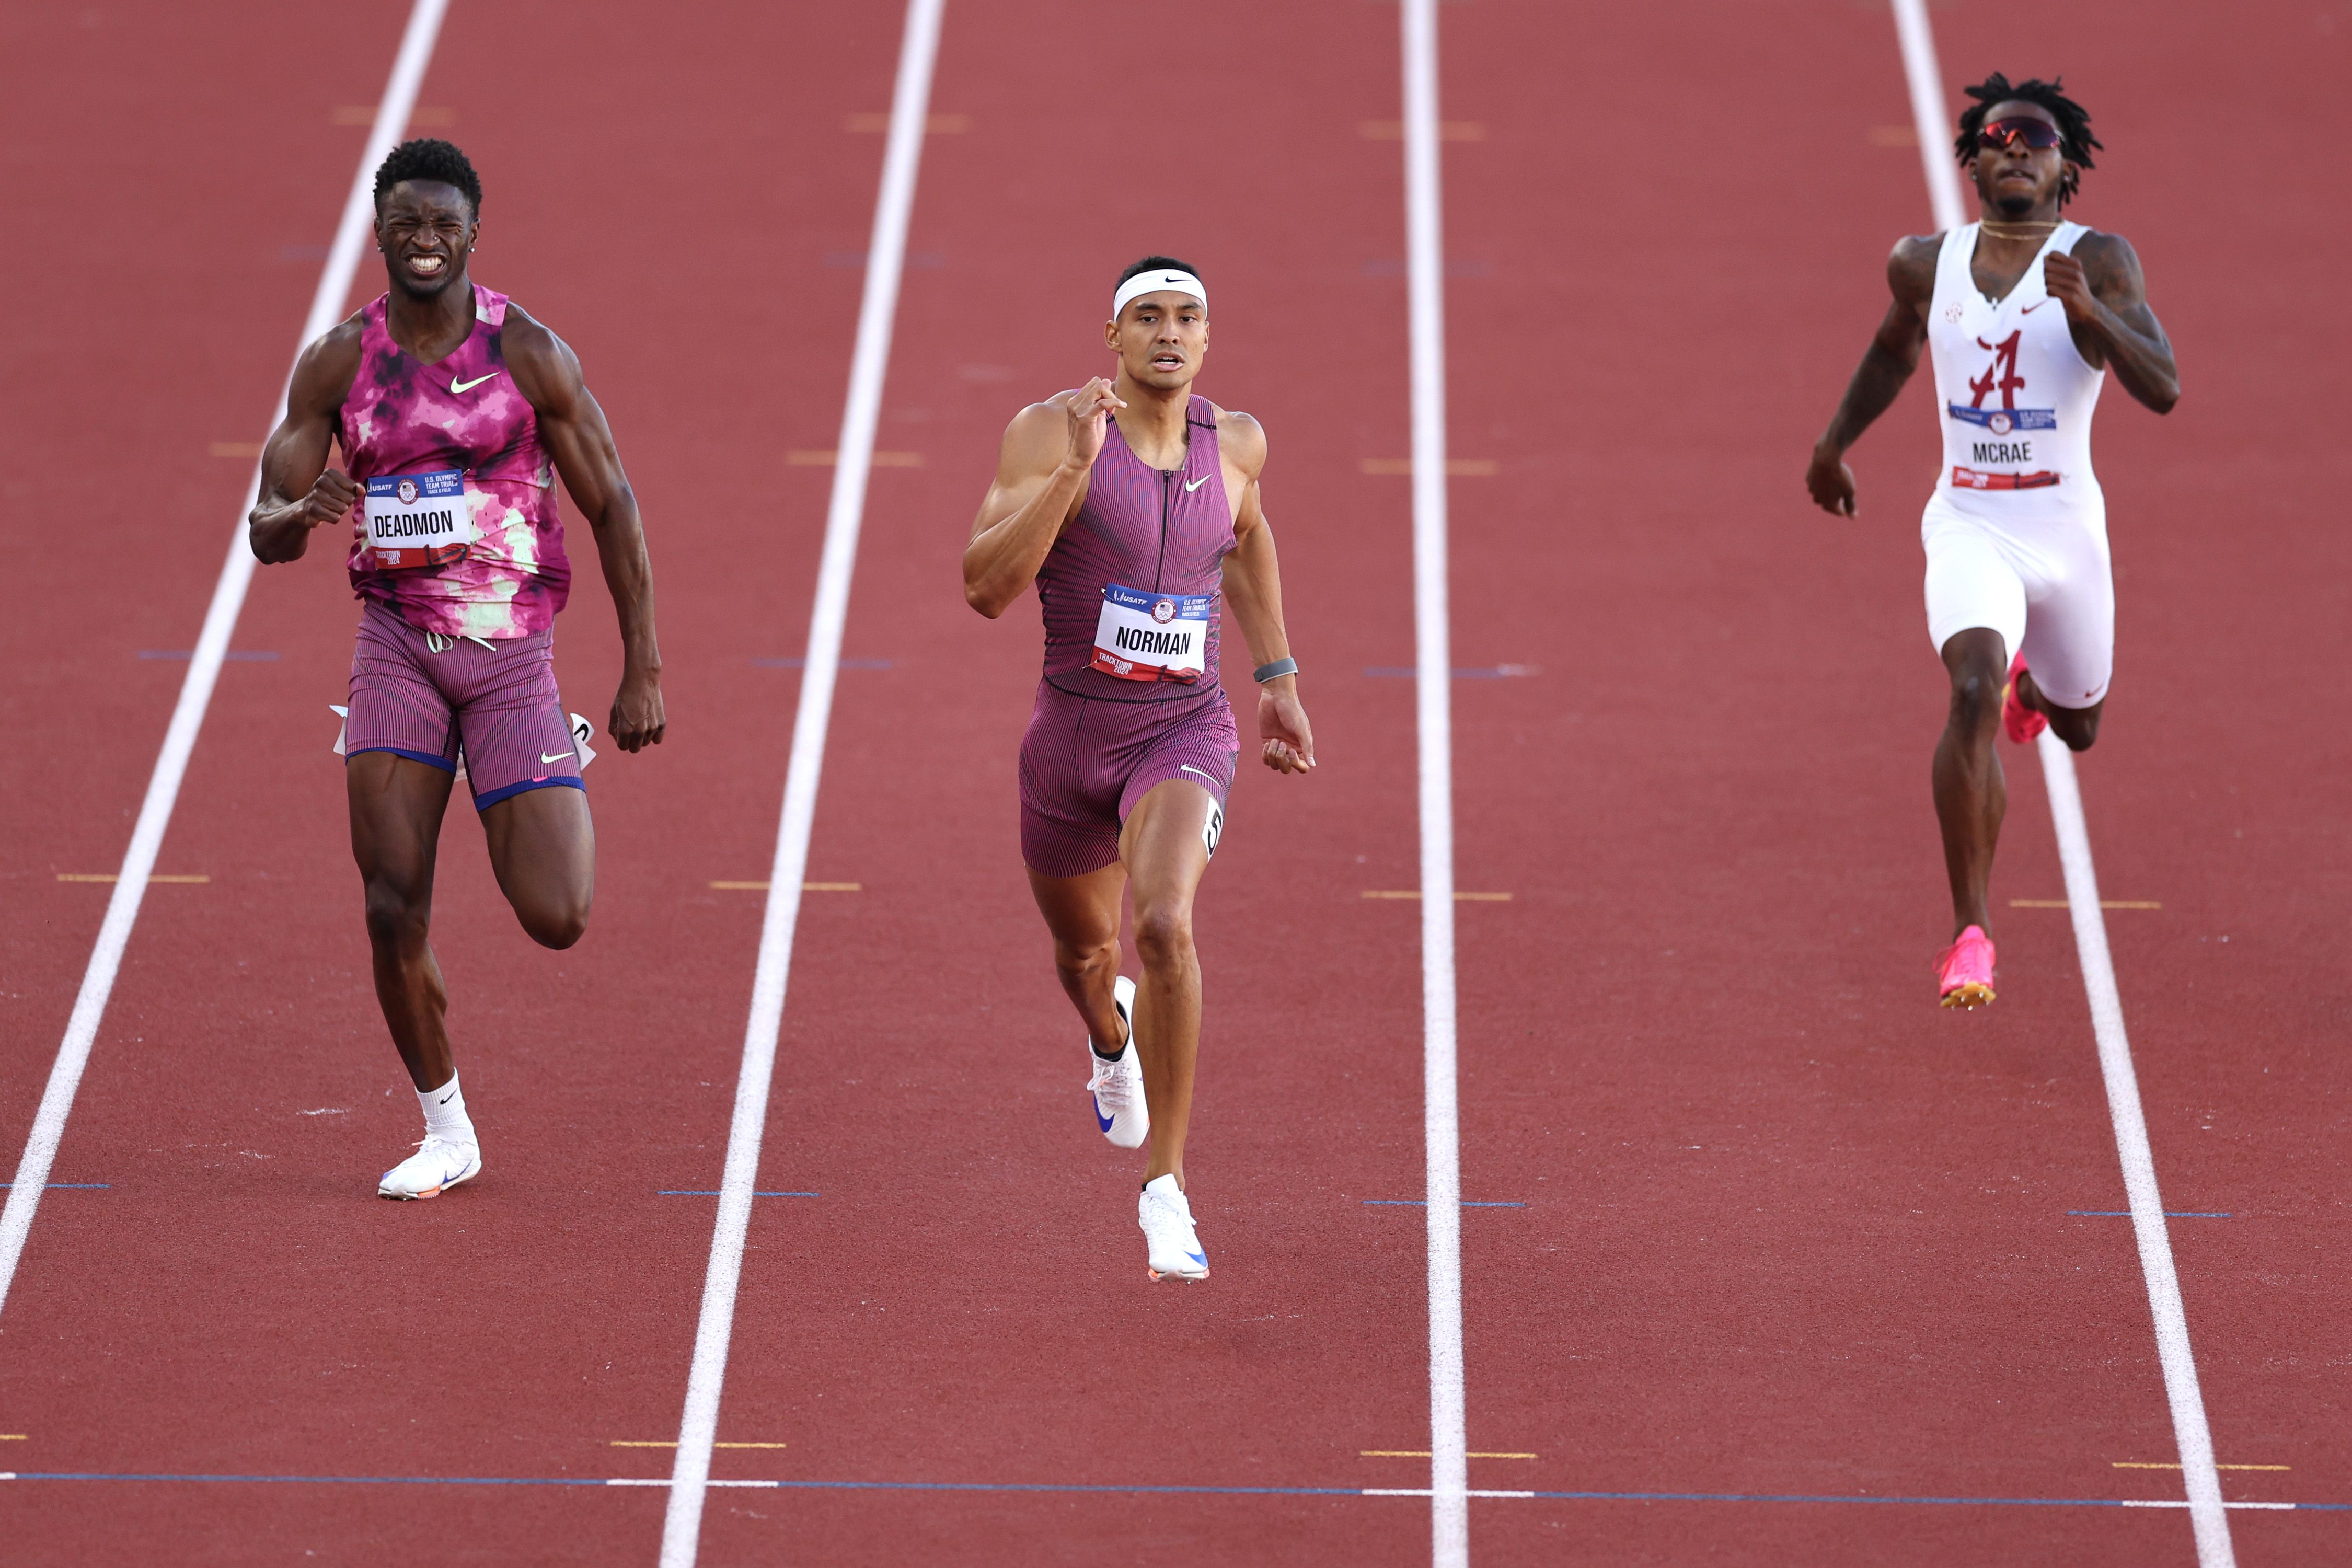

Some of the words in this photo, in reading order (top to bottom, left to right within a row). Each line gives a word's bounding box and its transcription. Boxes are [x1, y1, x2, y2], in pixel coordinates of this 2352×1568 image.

[1973, 441, 2032, 463] MCRAE
[435, 474, 457, 482] OLYMPIC
[374, 510, 454, 538] DEADMON
[1123, 596, 1148, 605] USATF
[1116, 626, 1191, 655] NORMAN
[1099, 652, 1133, 670] TRACKTOWN
[1113, 665, 1129, 675] 2024
[1207, 808, 1222, 855] 5
